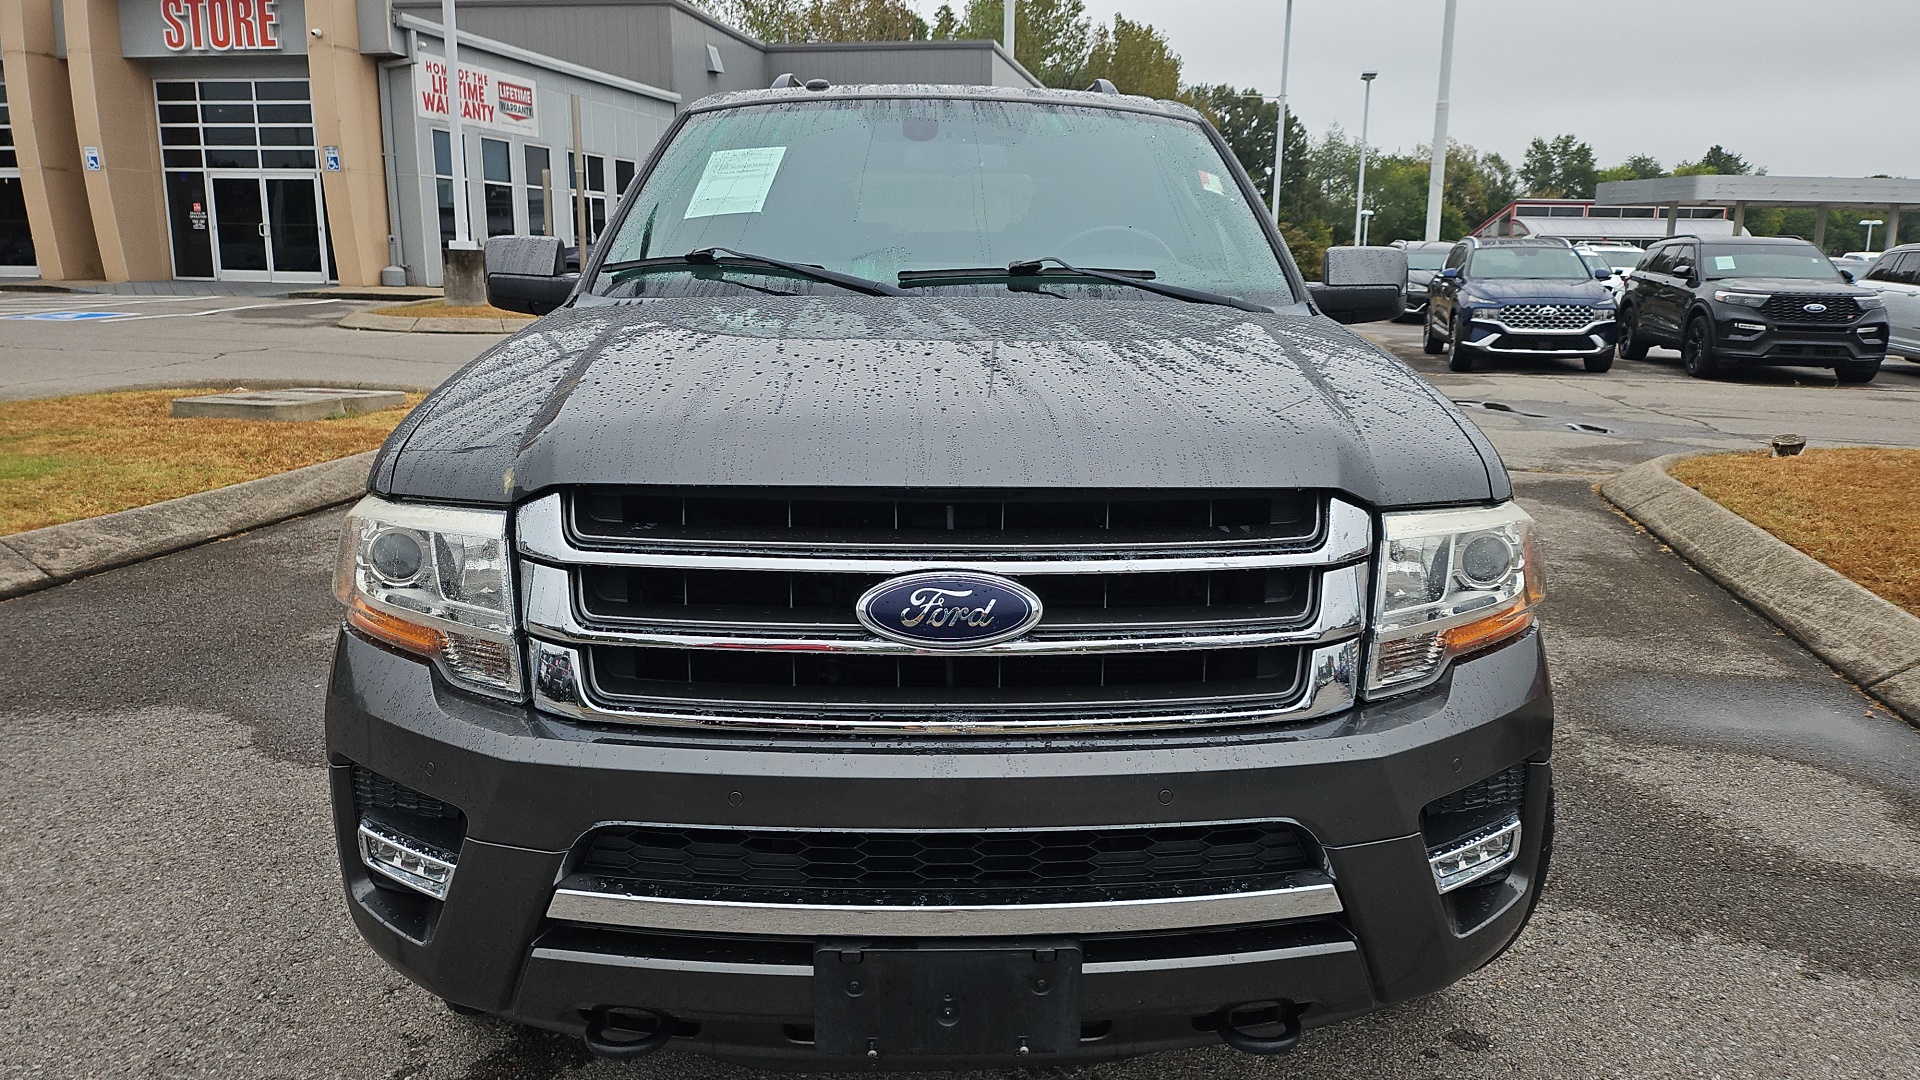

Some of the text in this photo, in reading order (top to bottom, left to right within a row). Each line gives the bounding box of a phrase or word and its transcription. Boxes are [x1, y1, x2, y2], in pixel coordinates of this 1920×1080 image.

[161, 0, 278, 51] STORE
[431, 74, 485, 103] LIFTIME
[458, 68, 469, 82] OF
[472, 72, 488, 86] THE
[422, 91, 494, 123] WAANTY
[499, 84, 532, 104] LIFETIME
[500, 101, 533, 117] WARRANTY
[901, 587, 997, 627] Ford
